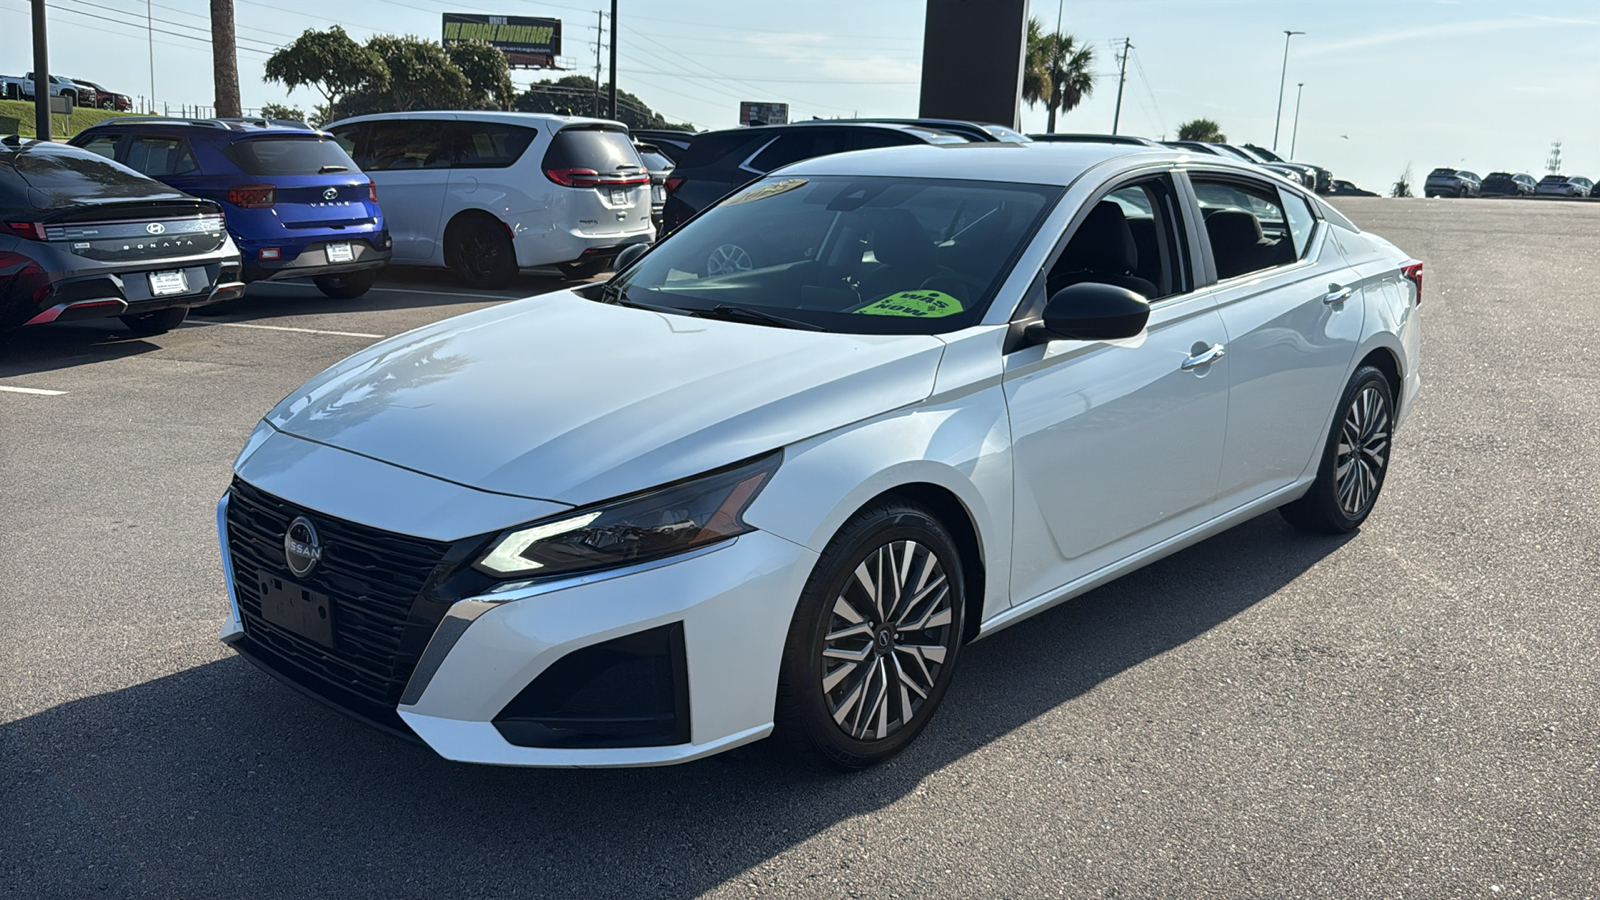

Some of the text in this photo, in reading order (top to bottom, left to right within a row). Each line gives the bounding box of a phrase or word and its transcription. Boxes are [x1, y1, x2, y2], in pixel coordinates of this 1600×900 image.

[444, 22, 554, 45] THE MIRACLE ADVANTAGE?
[123, 240, 193, 250] SONATA
[900, 293, 949, 309] WAS
[873, 304, 928, 316] NOW
